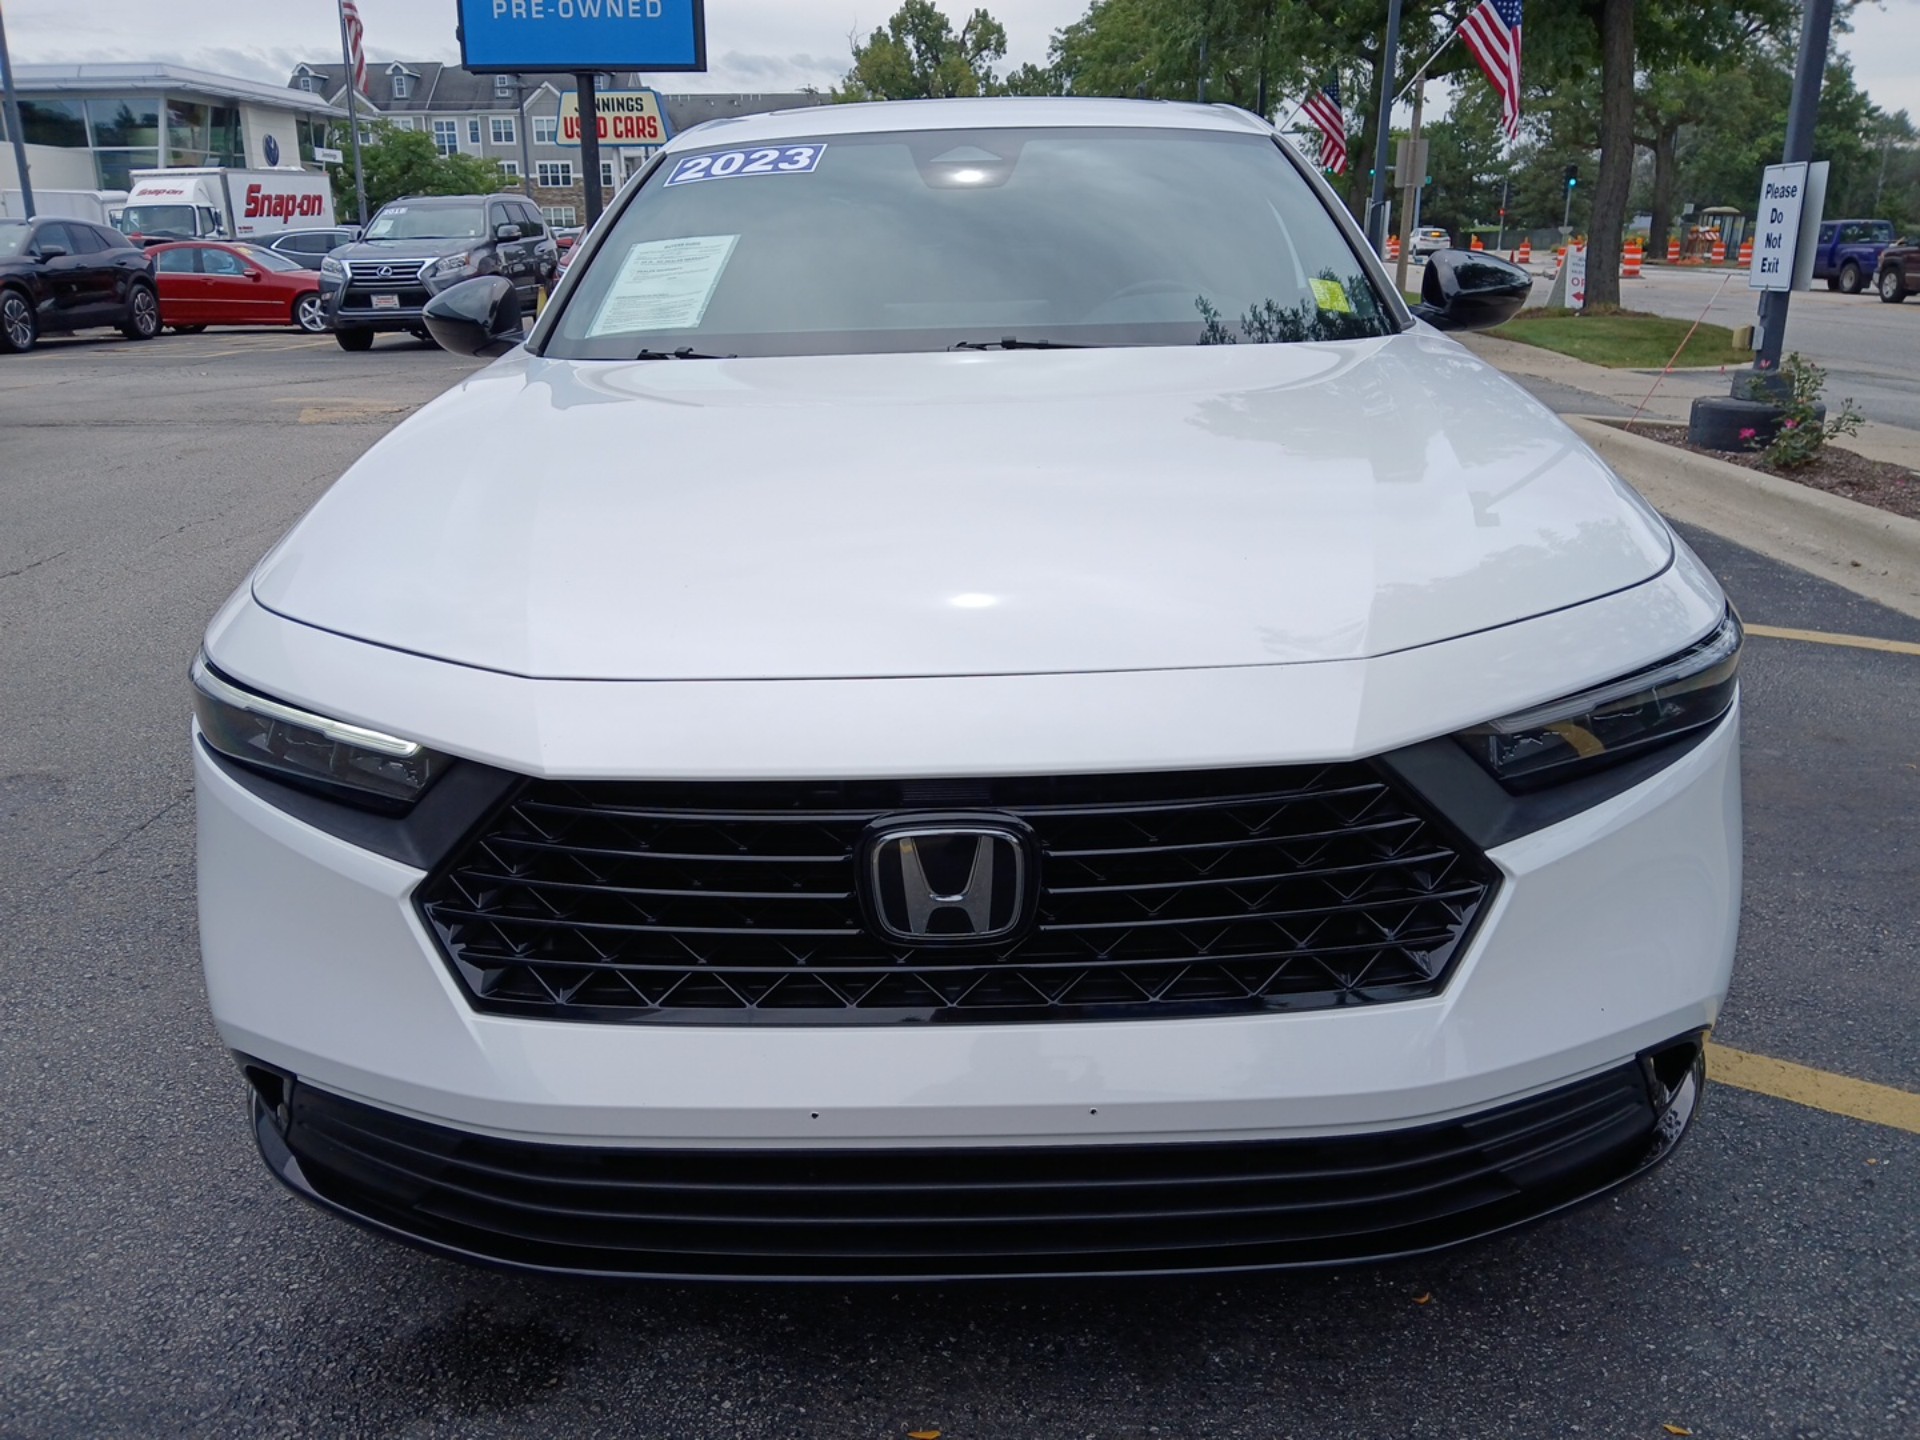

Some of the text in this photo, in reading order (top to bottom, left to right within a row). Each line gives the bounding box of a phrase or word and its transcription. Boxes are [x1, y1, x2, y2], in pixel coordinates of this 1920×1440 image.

[492, 0, 662, 19] PRE-OWNED
[612, 115, 658, 139] CARS
[674, 147, 815, 182] 2023
[1765, 183, 1798, 200] Please
[244, 183, 323, 224] Snap-on
[1770, 207, 1784, 224] Do
[1764, 231, 1782, 249] Not
[1760, 256, 1779, 274] Exit
